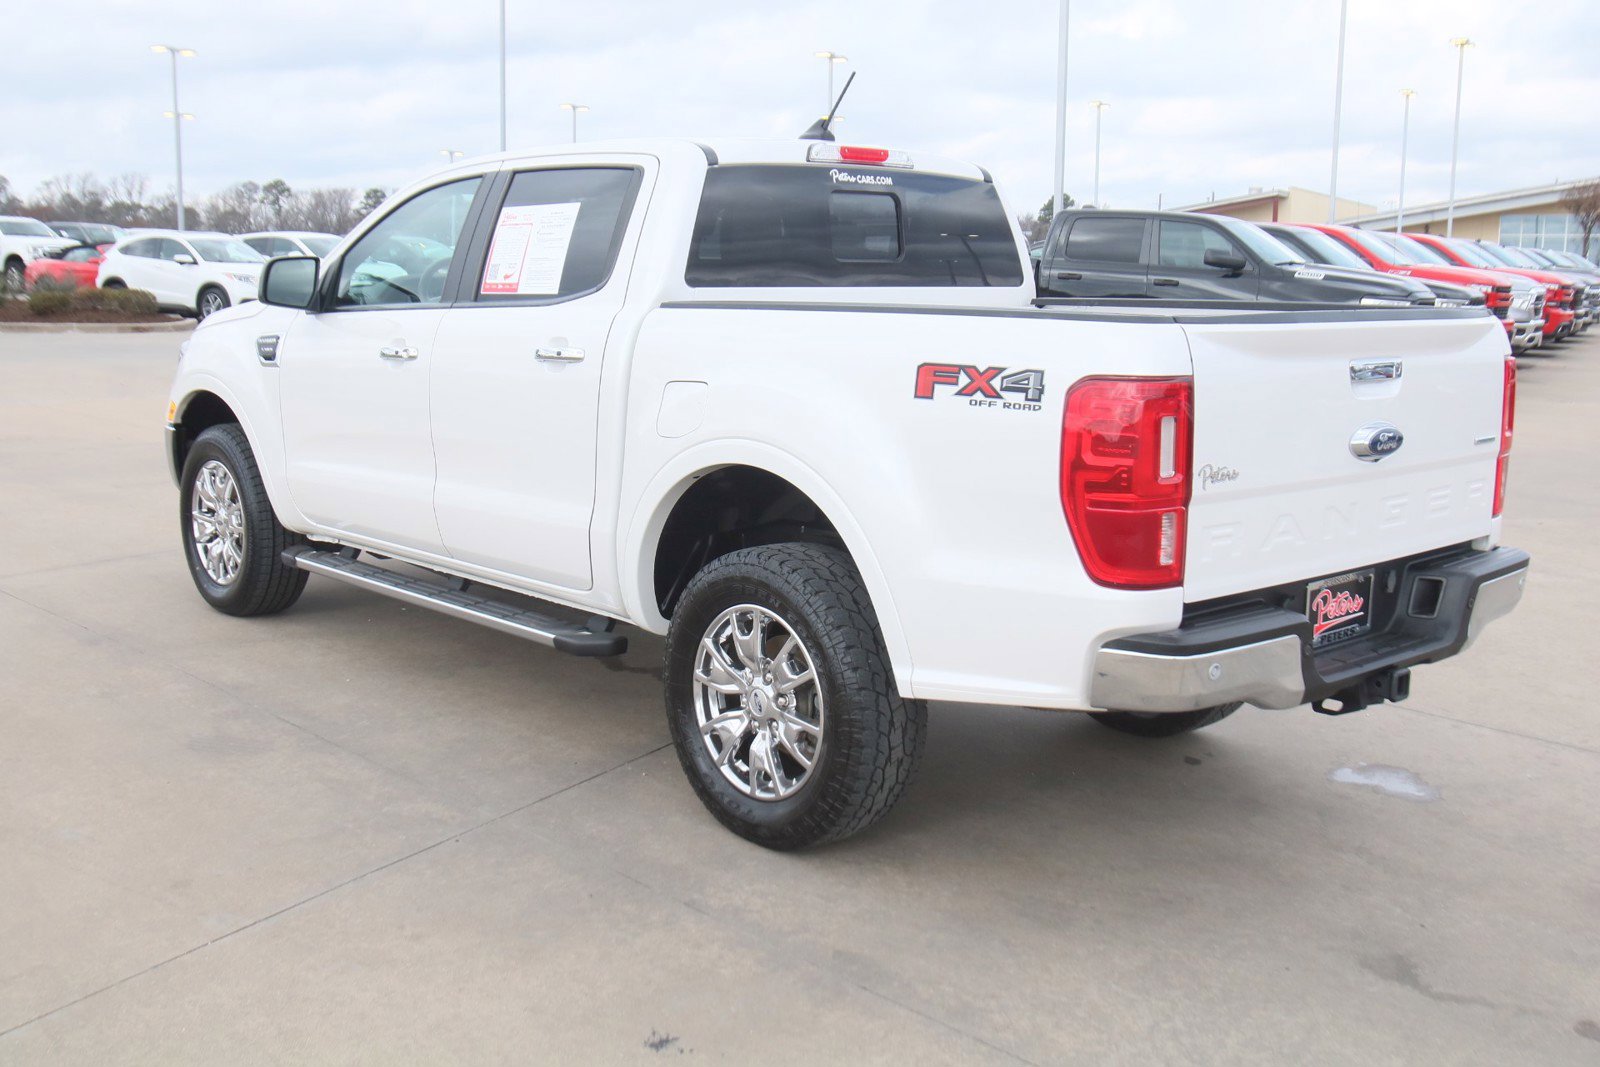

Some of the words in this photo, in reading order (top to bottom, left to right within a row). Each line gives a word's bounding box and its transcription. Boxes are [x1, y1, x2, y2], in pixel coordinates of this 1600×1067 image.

[914, 362, 1045, 402] FX4
[968, 398, 998, 408] OFF
[1002, 401, 1042, 412] ROAD
[1198, 463, 1240, 491] Peters
[1201, 479, 1488, 563] RANGER
[1312, 588, 1364, 626] Peters
